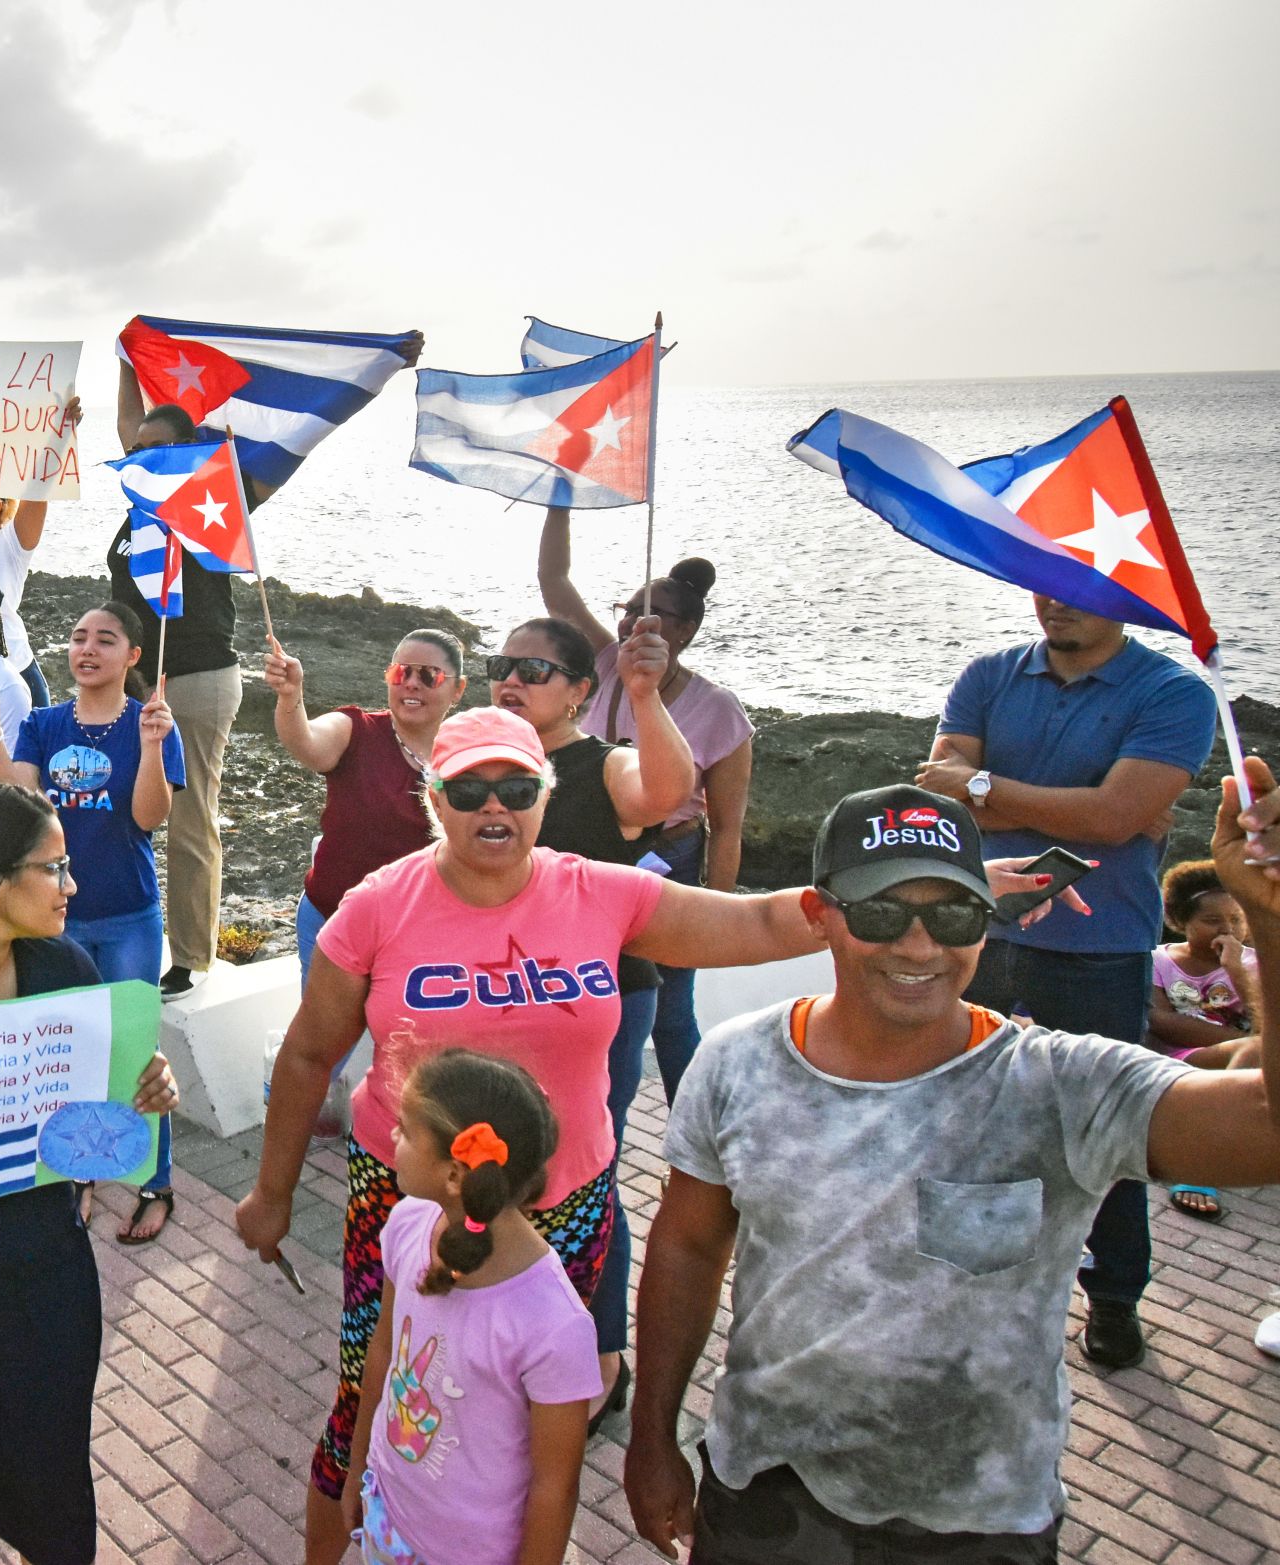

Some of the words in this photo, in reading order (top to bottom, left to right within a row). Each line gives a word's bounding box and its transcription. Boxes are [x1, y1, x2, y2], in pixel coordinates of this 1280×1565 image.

[6, 351, 54, 393] LA
[10, 444, 80, 486] VIDA
[46, 788, 114, 812] CUBA
[882, 807, 899, 829] I
[902, 810, 939, 823] Love
[403, 956, 620, 1012] Cuba
[22, 1032, 32, 1046] y
[36, 1022, 73, 1037] Vida
[23, 1052, 31, 1066] y
[36, 1042, 72, 1057] Vida
[22, 1072, 31, 1086] y
[35, 1061, 71, 1077] Vida
[21, 1091, 30, 1105] y
[34, 1080, 70, 1096] Vida
[20, 1110, 29, 1124] y
[33, 1099, 68, 1115] Vida
